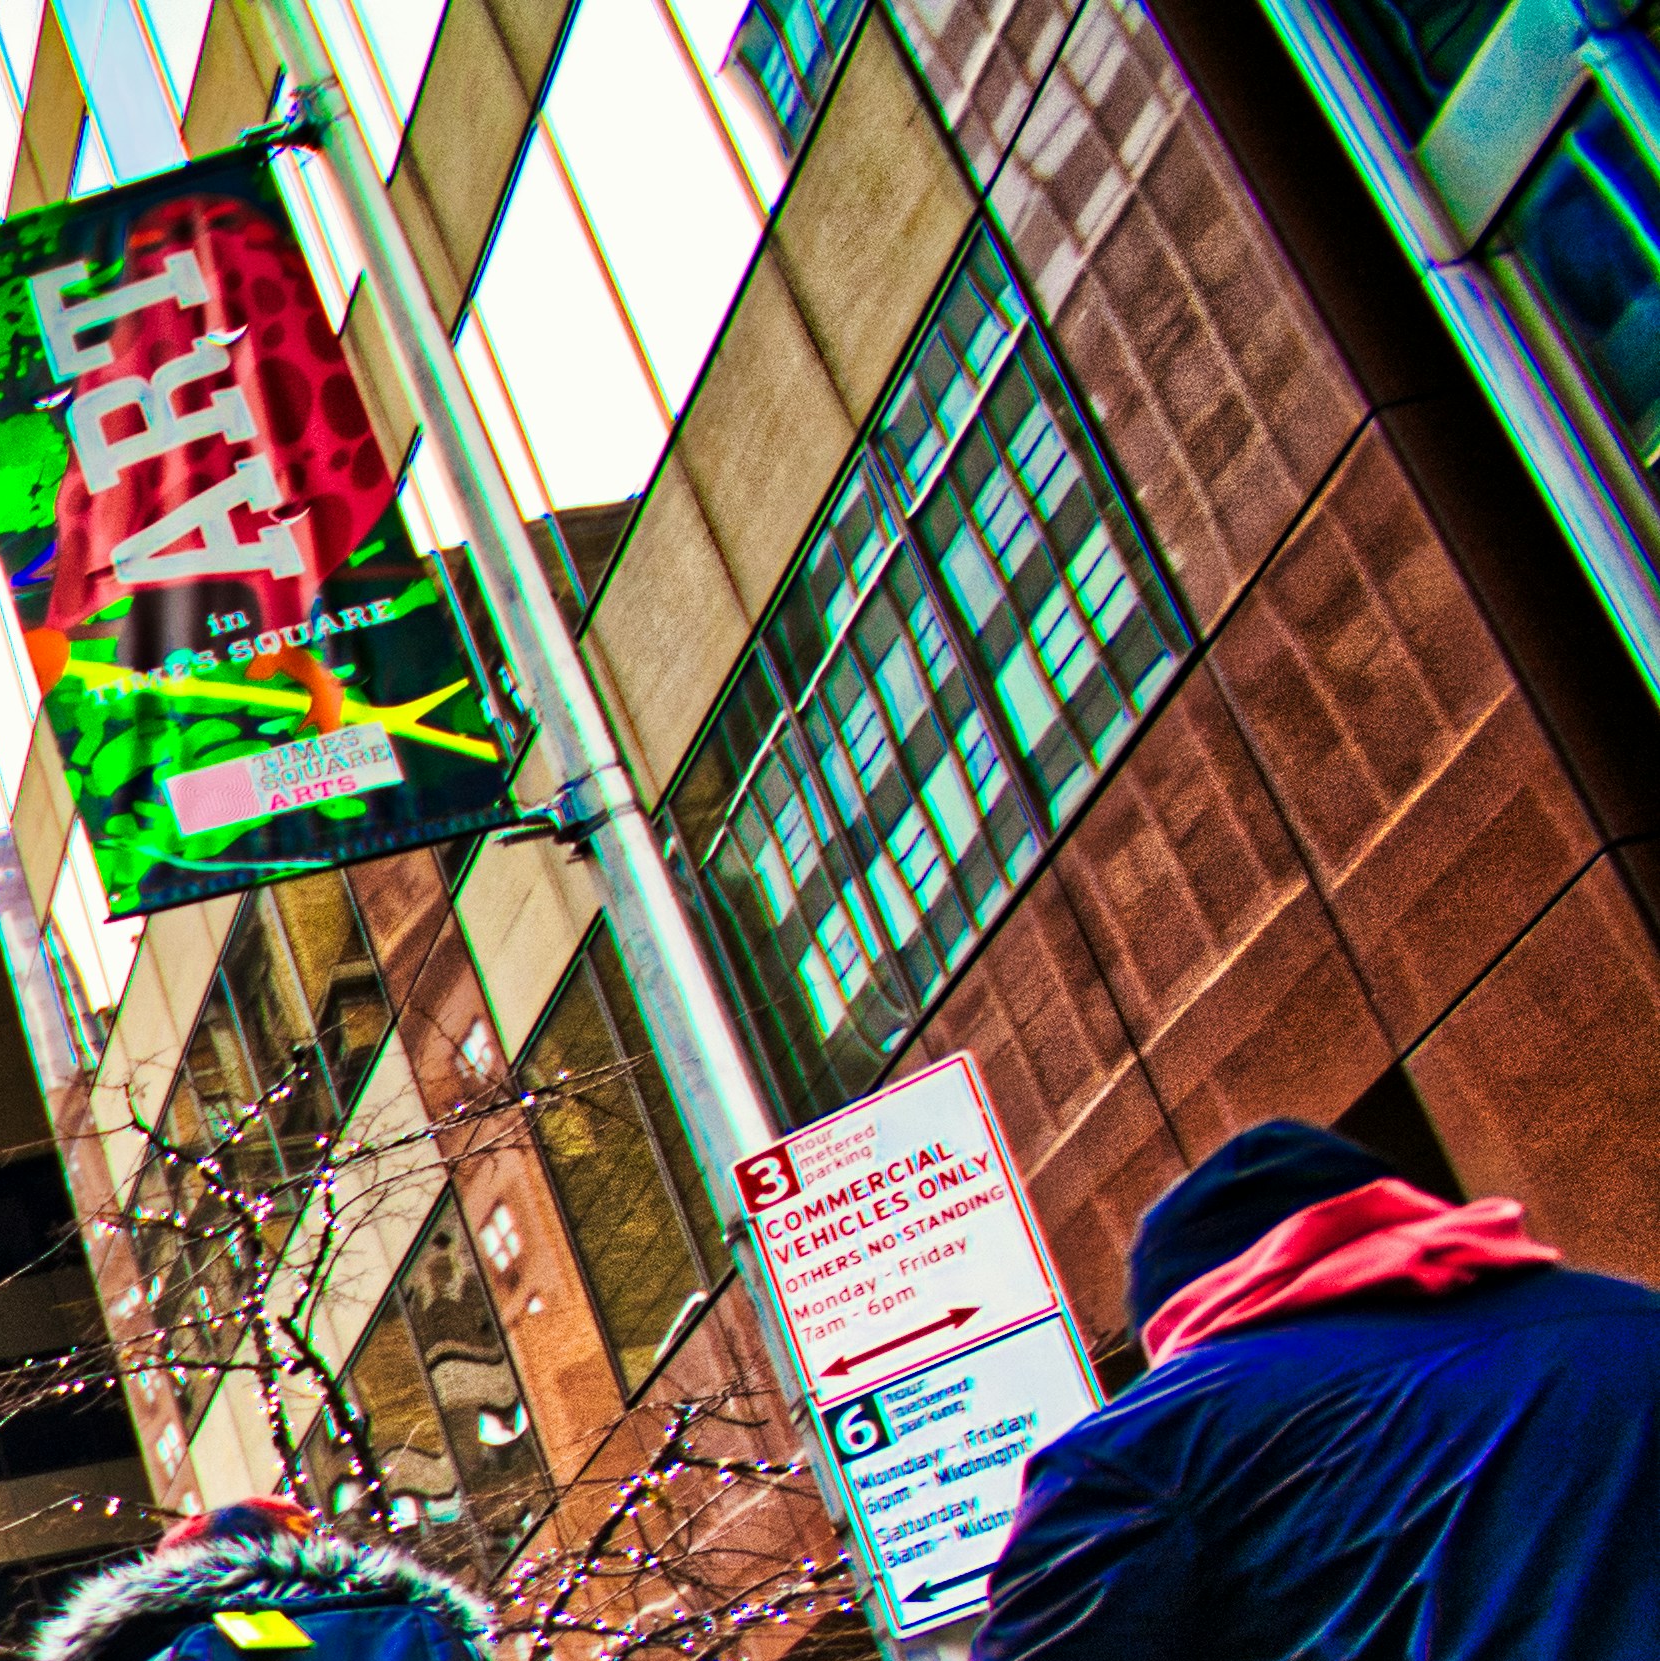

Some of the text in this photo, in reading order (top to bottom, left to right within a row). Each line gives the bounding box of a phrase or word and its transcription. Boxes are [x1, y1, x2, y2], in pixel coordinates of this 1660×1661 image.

[26, 249, 304, 583] ART
[206, 609, 250, 637] in
[84, 598, 396, 705] TIMES SQUARE
[251, 729, 362, 774] TIMES
[259, 743, 391, 793] SQUARE
[269, 774, 358, 813] ARTS
[793, 1127, 835, 1155] hour
[798, 1124, 877, 1170] metered
[803, 1144, 873, 1188] parking
[746, 1156, 790, 1206] 3
[765, 1142, 954, 1241] COMMERCIAL
[773, 1151, 990, 1266] VEHICLES ONLY
[784, 1184, 1006, 1294] OTHERS NO STANDING
[792, 1276, 877, 1324] Monday
[898, 1236, 968, 1278] Friday
[800, 1315, 847, 1345] 7am
[867, 1285, 917, 1317] 6pm
[835, 1403, 879, 1456] 6
[853, 1448, 945, 1493] Monday
[963, 1410, 1038, 1450] Friday
[874, 1496, 980, 1546] Saturday
